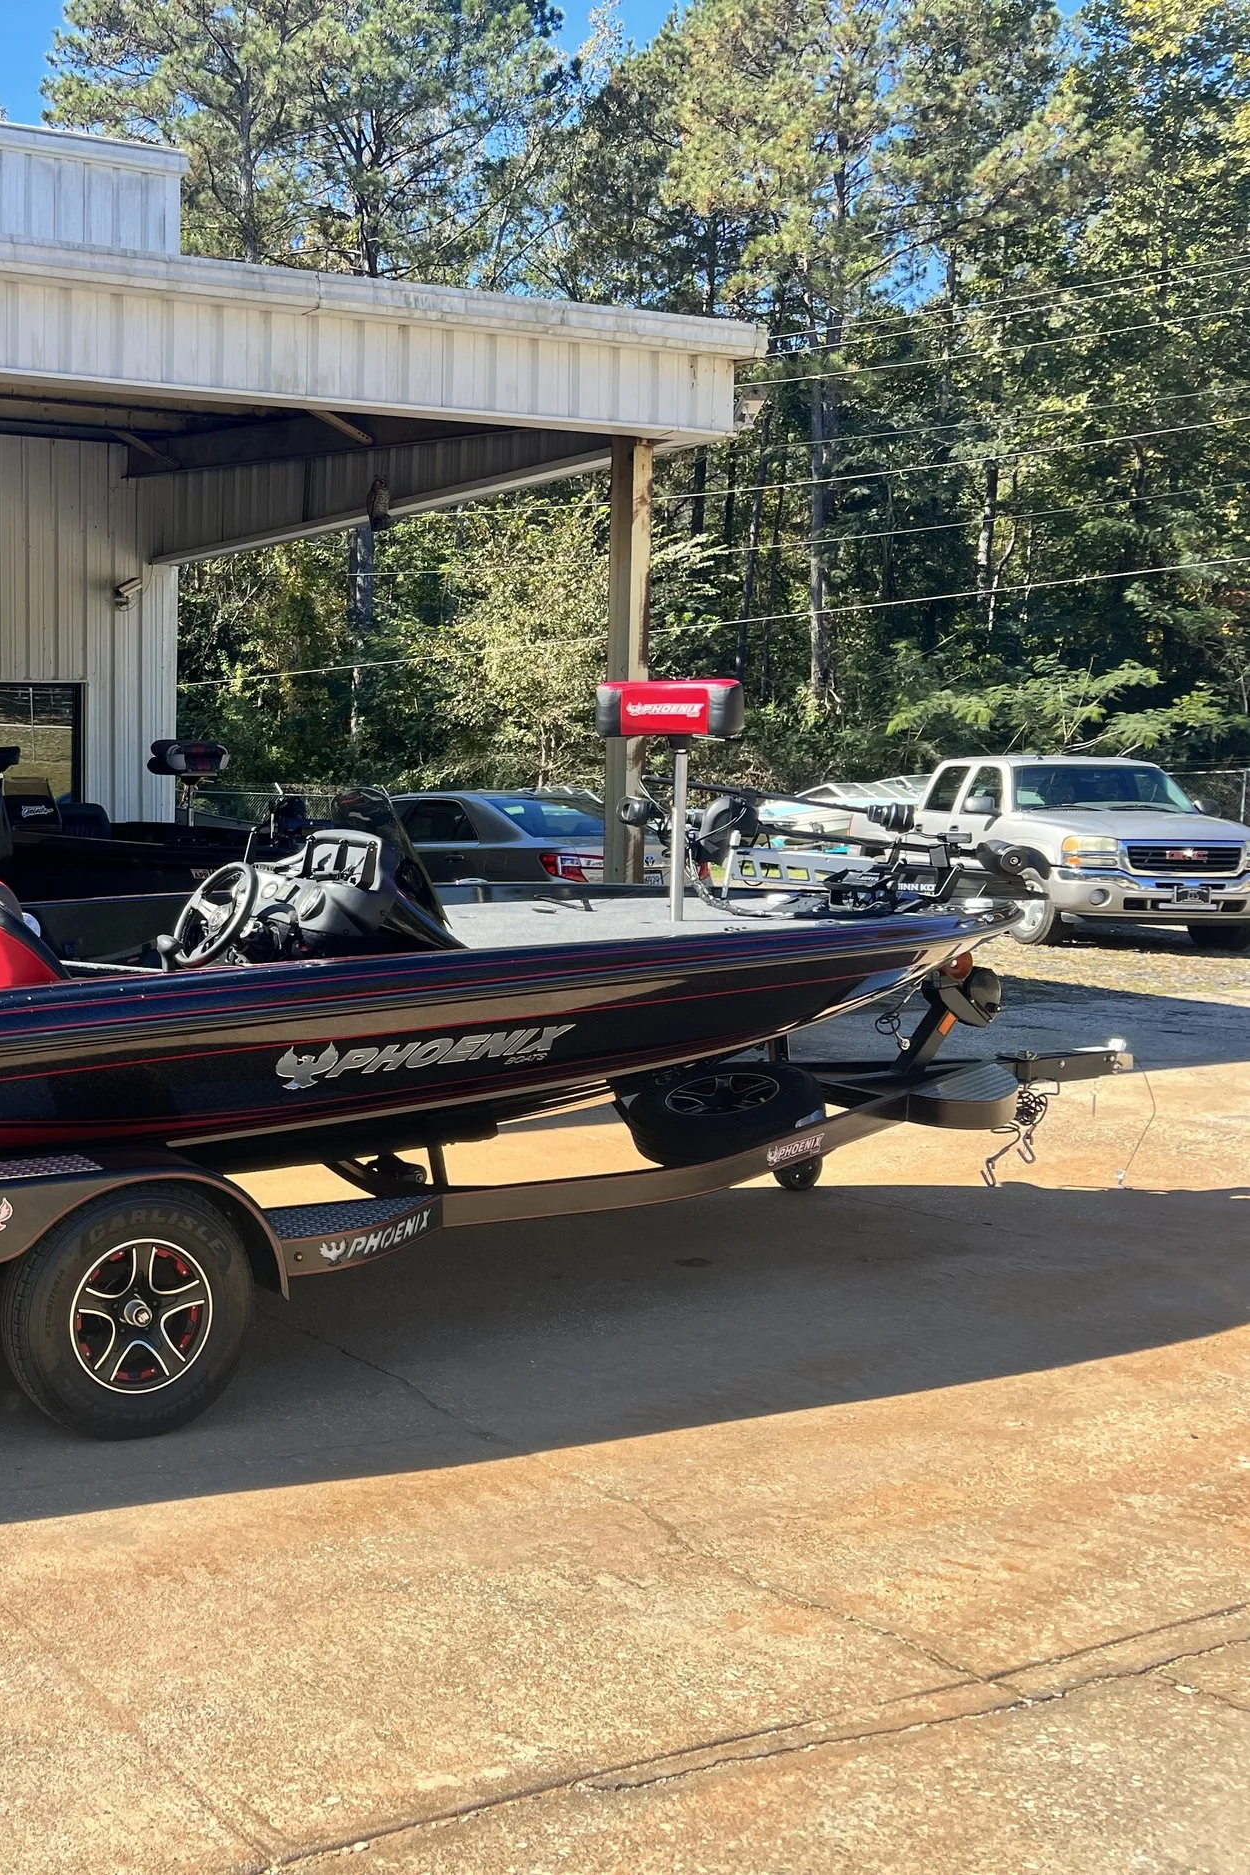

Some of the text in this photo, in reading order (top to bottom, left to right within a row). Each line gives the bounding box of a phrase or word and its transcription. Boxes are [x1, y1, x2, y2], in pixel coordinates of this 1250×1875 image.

[642, 703, 704, 715] PHOENIX
[325, 1024, 577, 1079] PHOENIX
[503, 1052, 548, 1065] BOATS
[779, 1136, 822, 1157] PHOENIX
[88, 1207, 228, 1256] CARLISLE
[347, 1208, 431, 1258] PHOENIX
